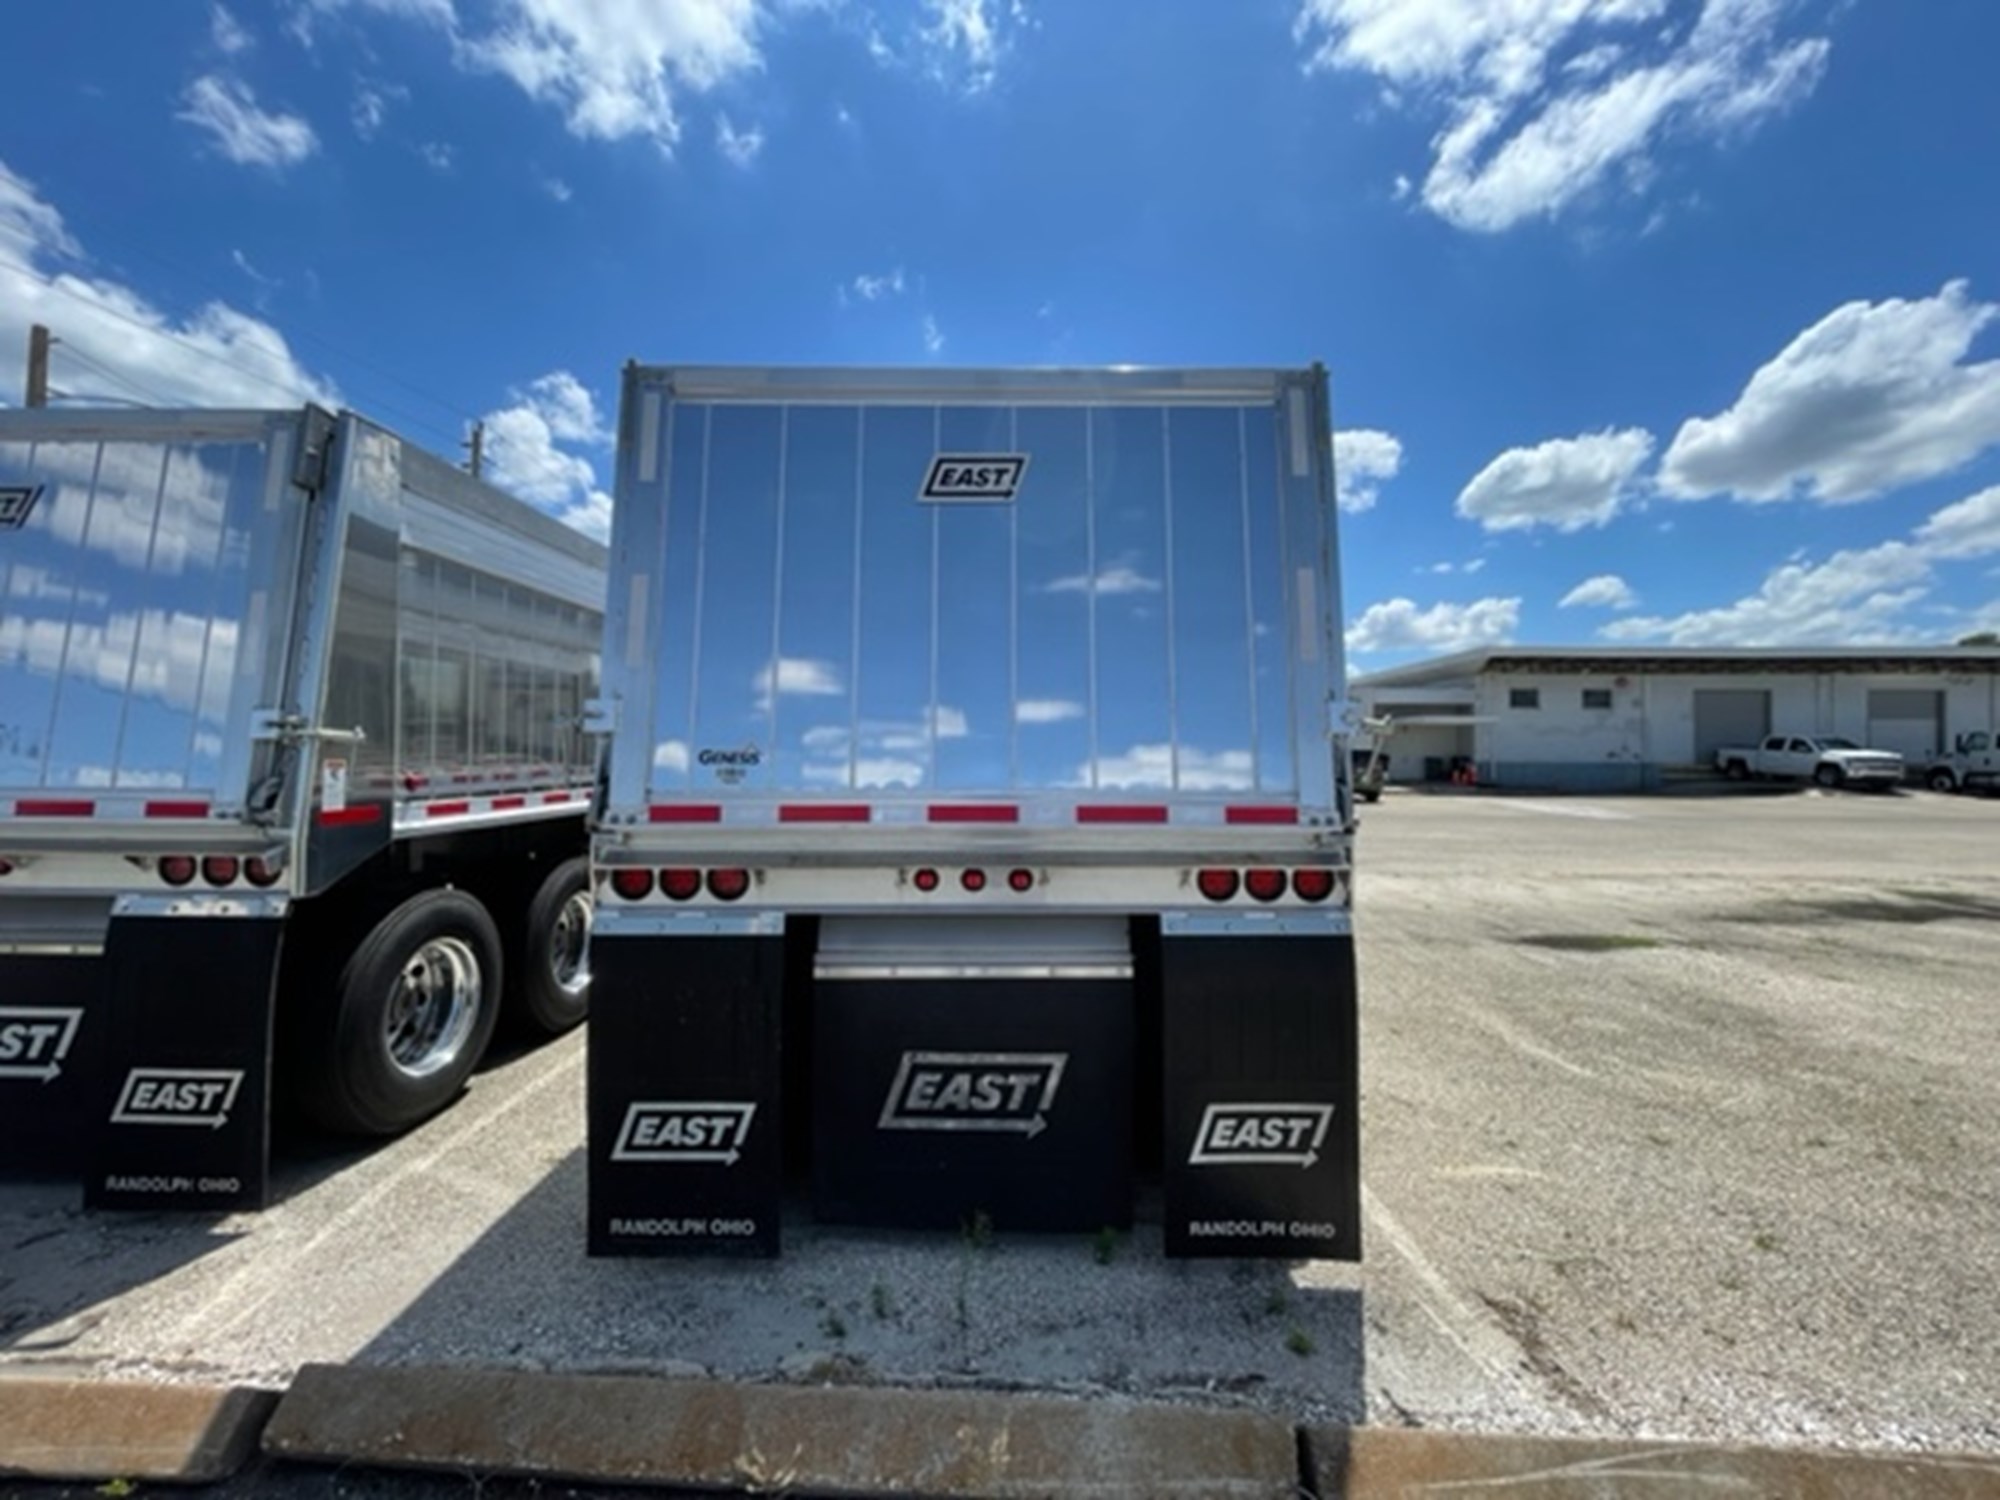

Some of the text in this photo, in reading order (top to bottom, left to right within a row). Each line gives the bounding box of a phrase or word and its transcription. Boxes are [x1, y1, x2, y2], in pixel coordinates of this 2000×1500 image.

[938, 467, 1010, 487] EAST
[131, 1082, 223, 1110] EAST
[905, 1074, 1040, 1110] EAST
[632, 1117, 734, 1145] EAST
[1209, 1119, 1312, 1147] EAST
[106, 1175, 240, 1192] RANDOLPH OHIO
[609, 1218, 756, 1236] RANDOLPH OHIO
[1189, 1220, 1336, 1239] RANDOLPH OHIO
